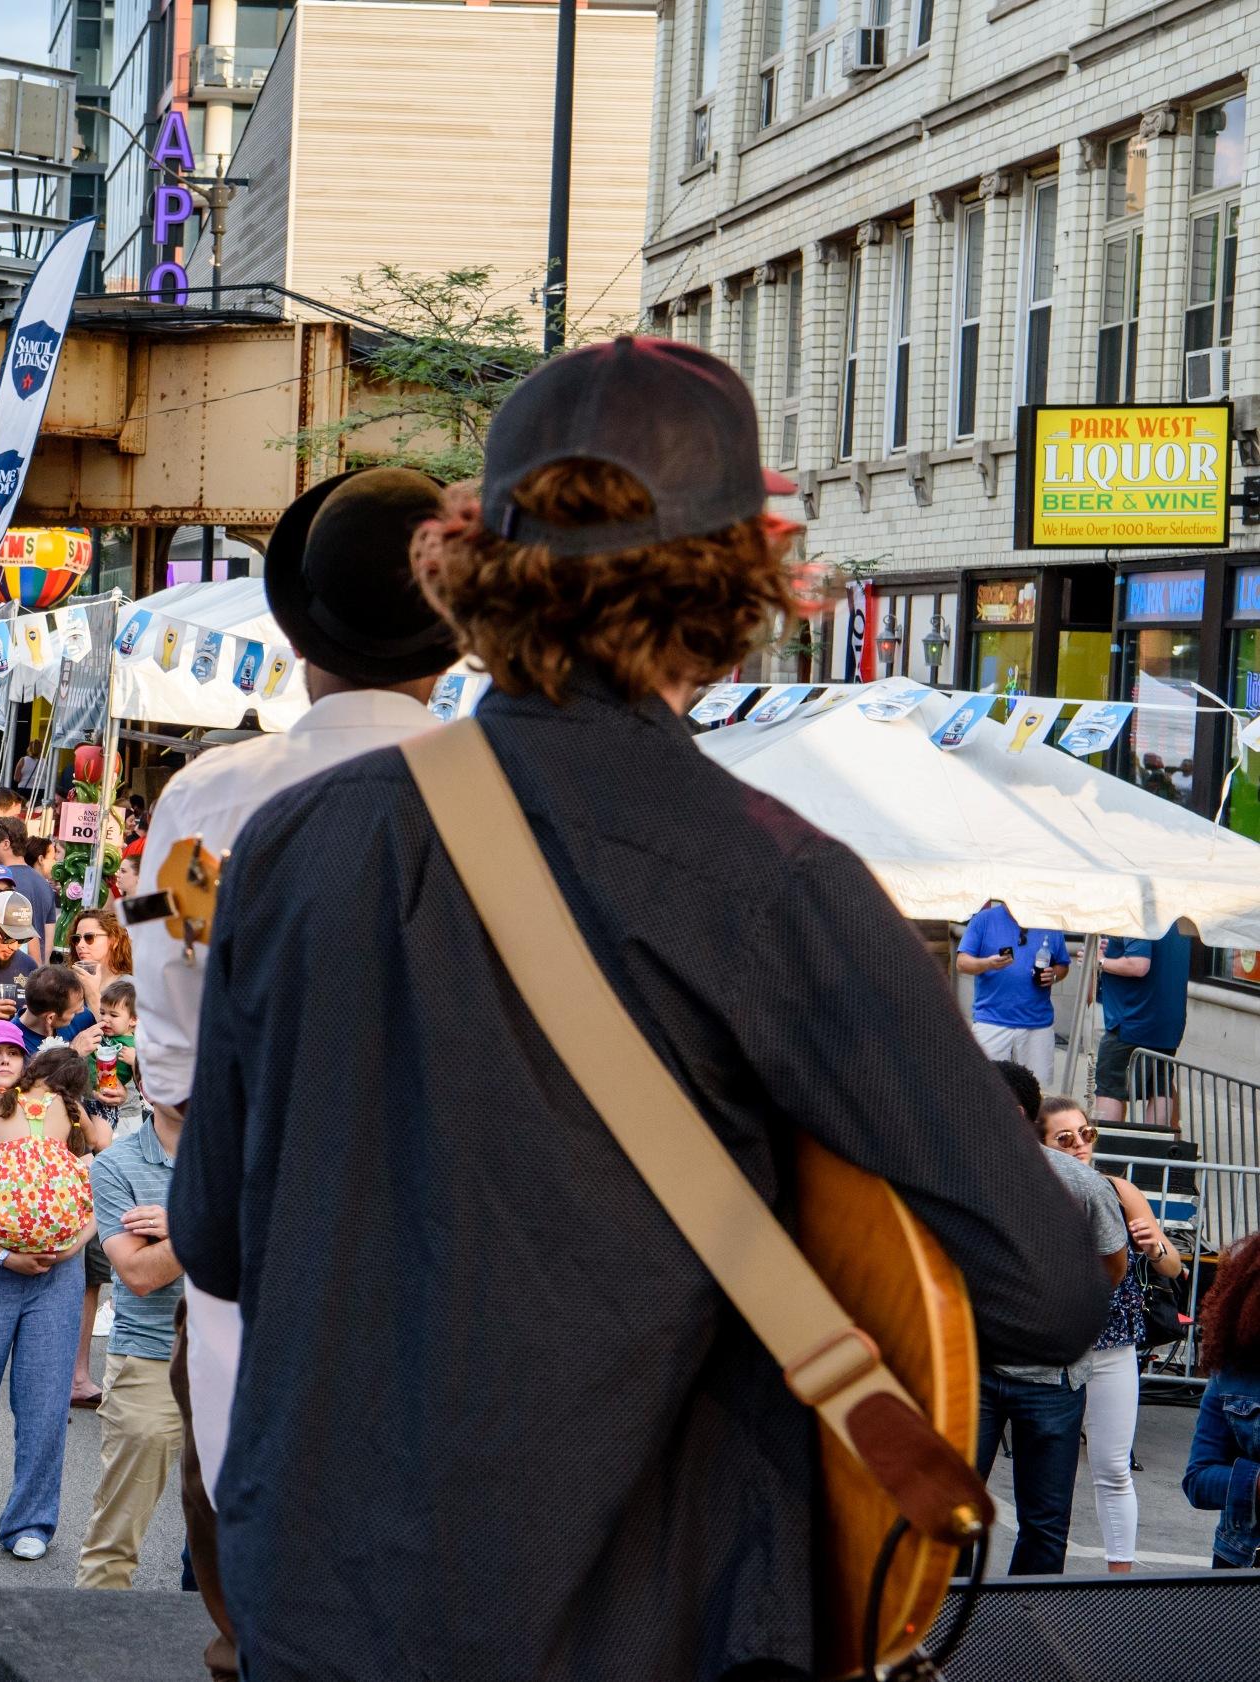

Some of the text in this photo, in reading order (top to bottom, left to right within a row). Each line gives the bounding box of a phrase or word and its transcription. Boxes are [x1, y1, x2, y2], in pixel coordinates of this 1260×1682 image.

[1070, 416, 1197, 439] PARK WEST
[1043, 442, 1219, 491] LIQUOR
[1043, 493, 1217, 510] BEER & WINE
[1042, 520, 1217, 536] We Have Over 1000 Beer Selections
[1129, 582, 1164, 615] PARK
[72, 826, 114, 841] ROÉ
